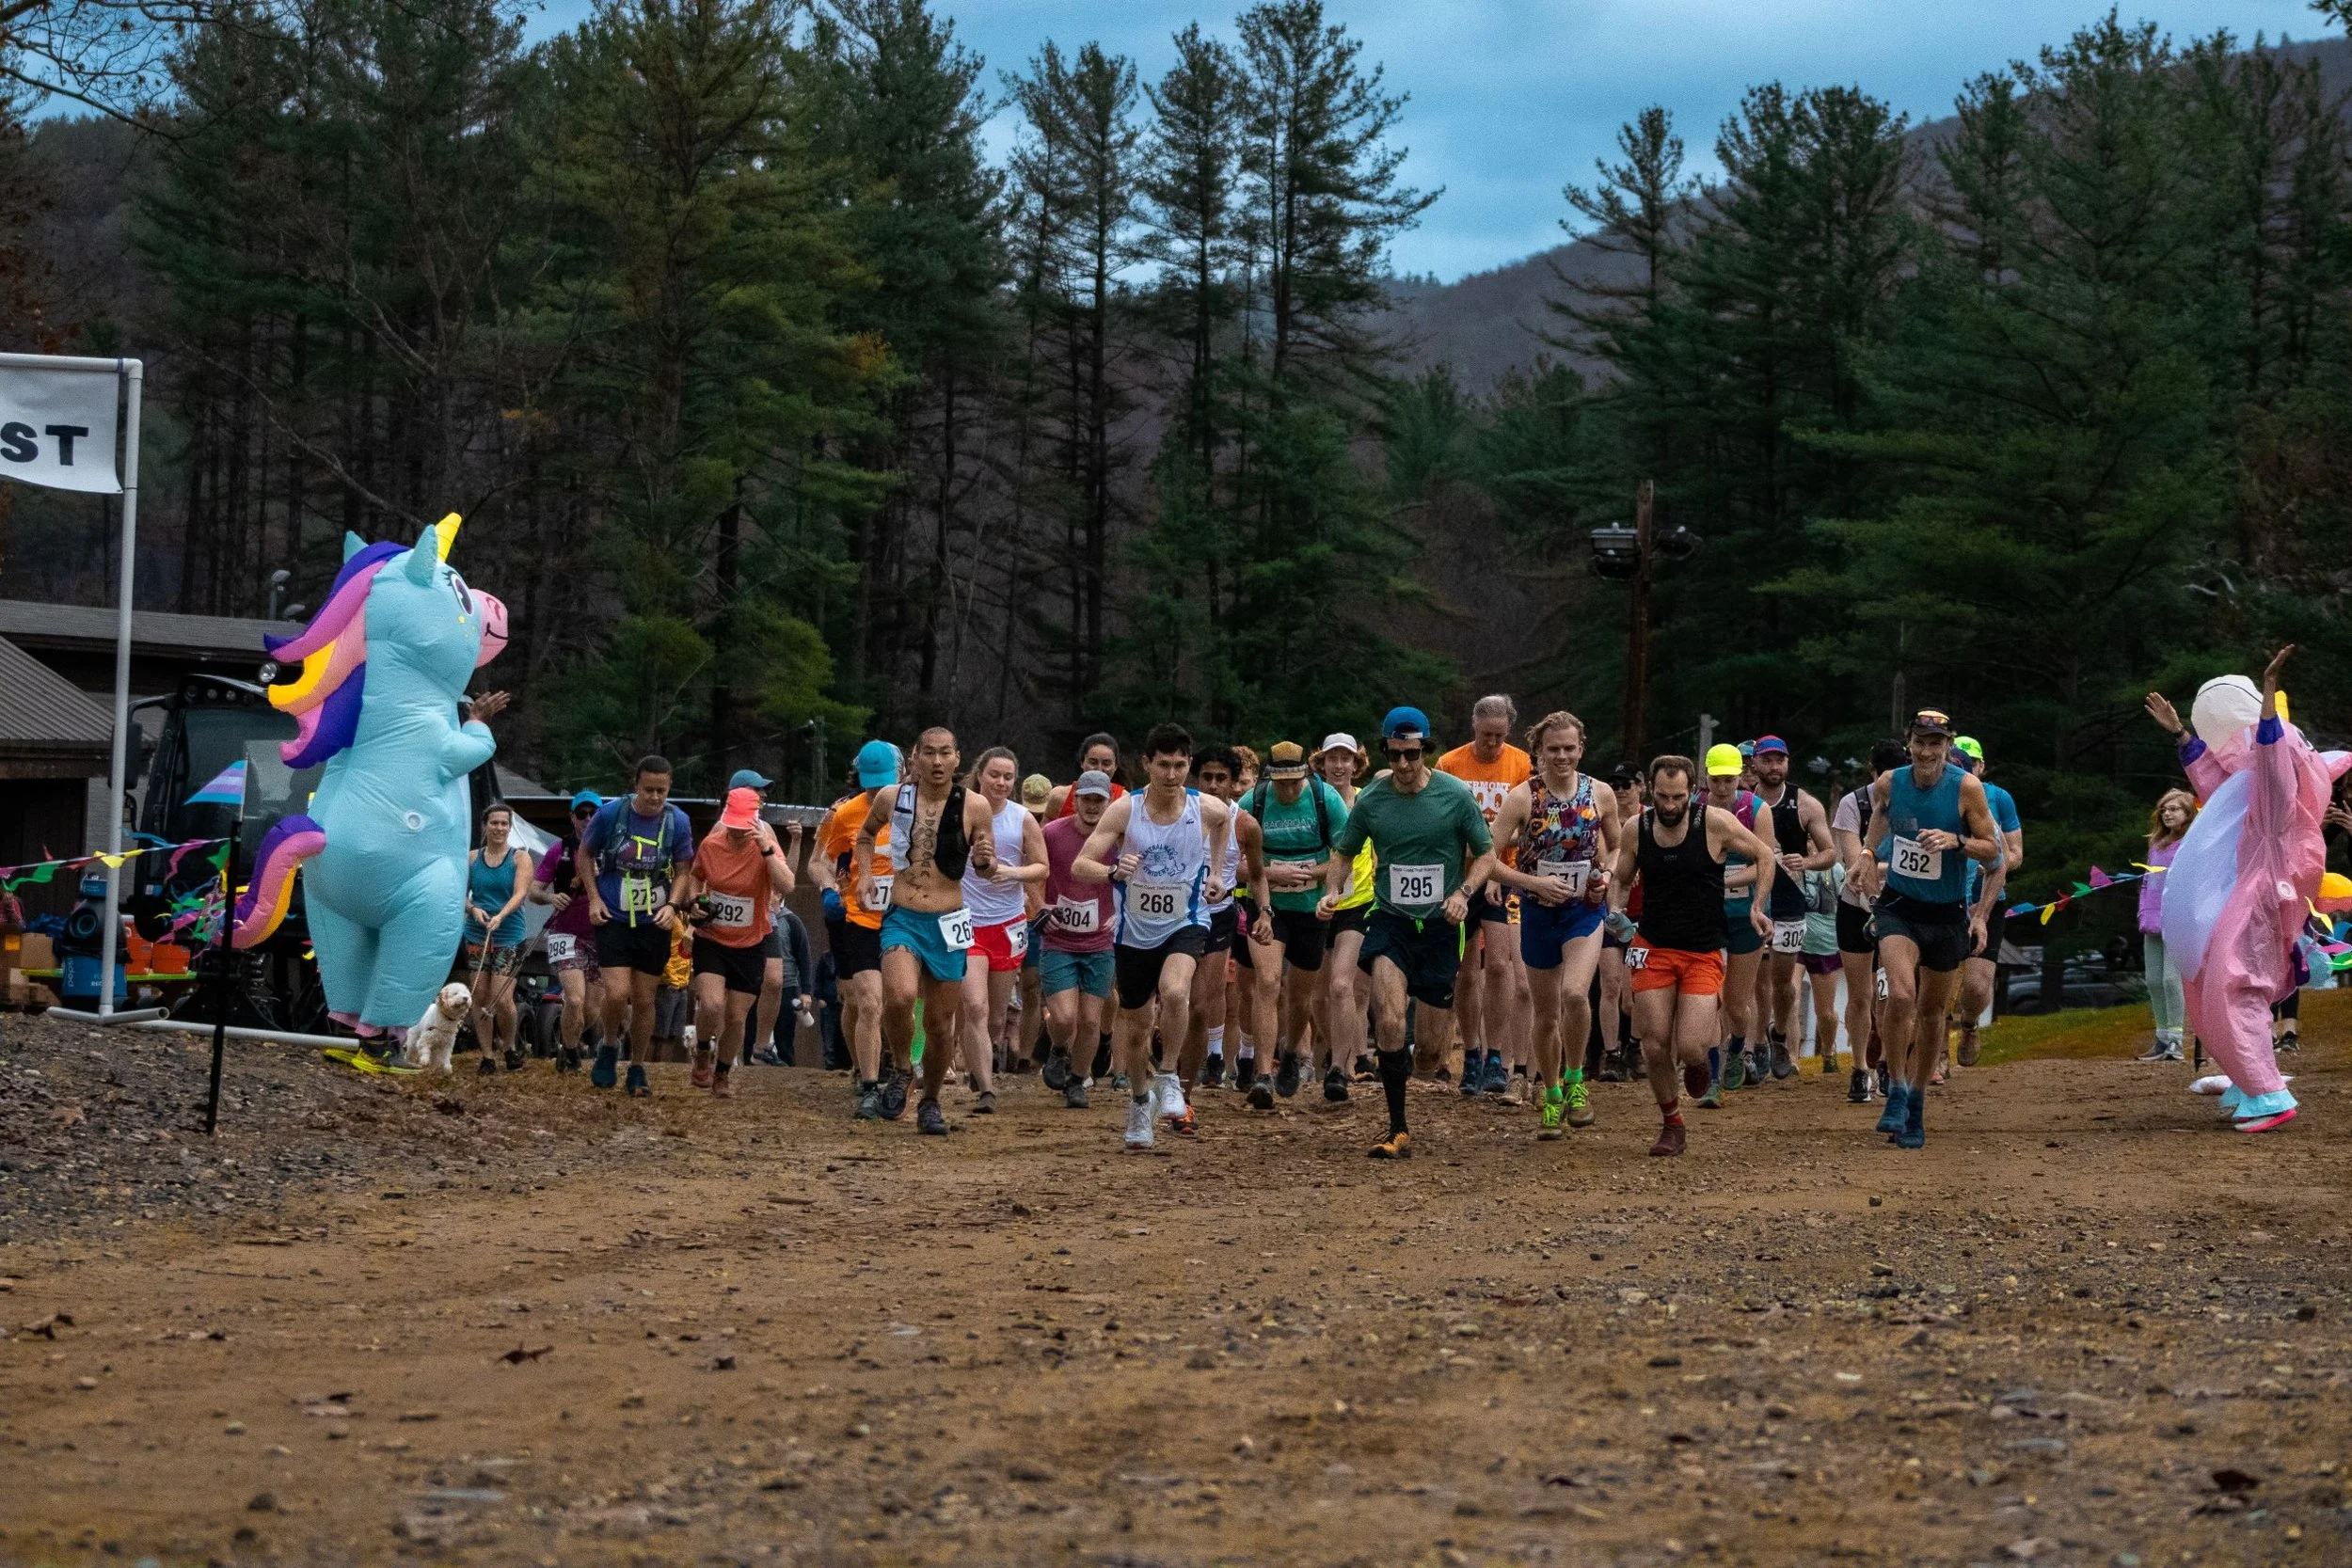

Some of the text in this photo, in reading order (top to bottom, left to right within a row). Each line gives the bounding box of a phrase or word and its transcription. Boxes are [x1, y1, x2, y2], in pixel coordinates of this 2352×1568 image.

[0, 421, 88, 467] ST
[1467, 781, 1511, 791] ERMONT
[1263, 817, 1317, 830] BACKROAD
[1899, 849, 1931, 873] 252
[1400, 877, 1433, 898] 295
[1548, 872, 1579, 893] 71
[716, 902, 743, 922] 292
[1140, 893, 1174, 914] 268
[1063, 907, 1090, 927] 304
[1782, 929, 1804, 947] 302
[548, 941, 566, 958] 298
